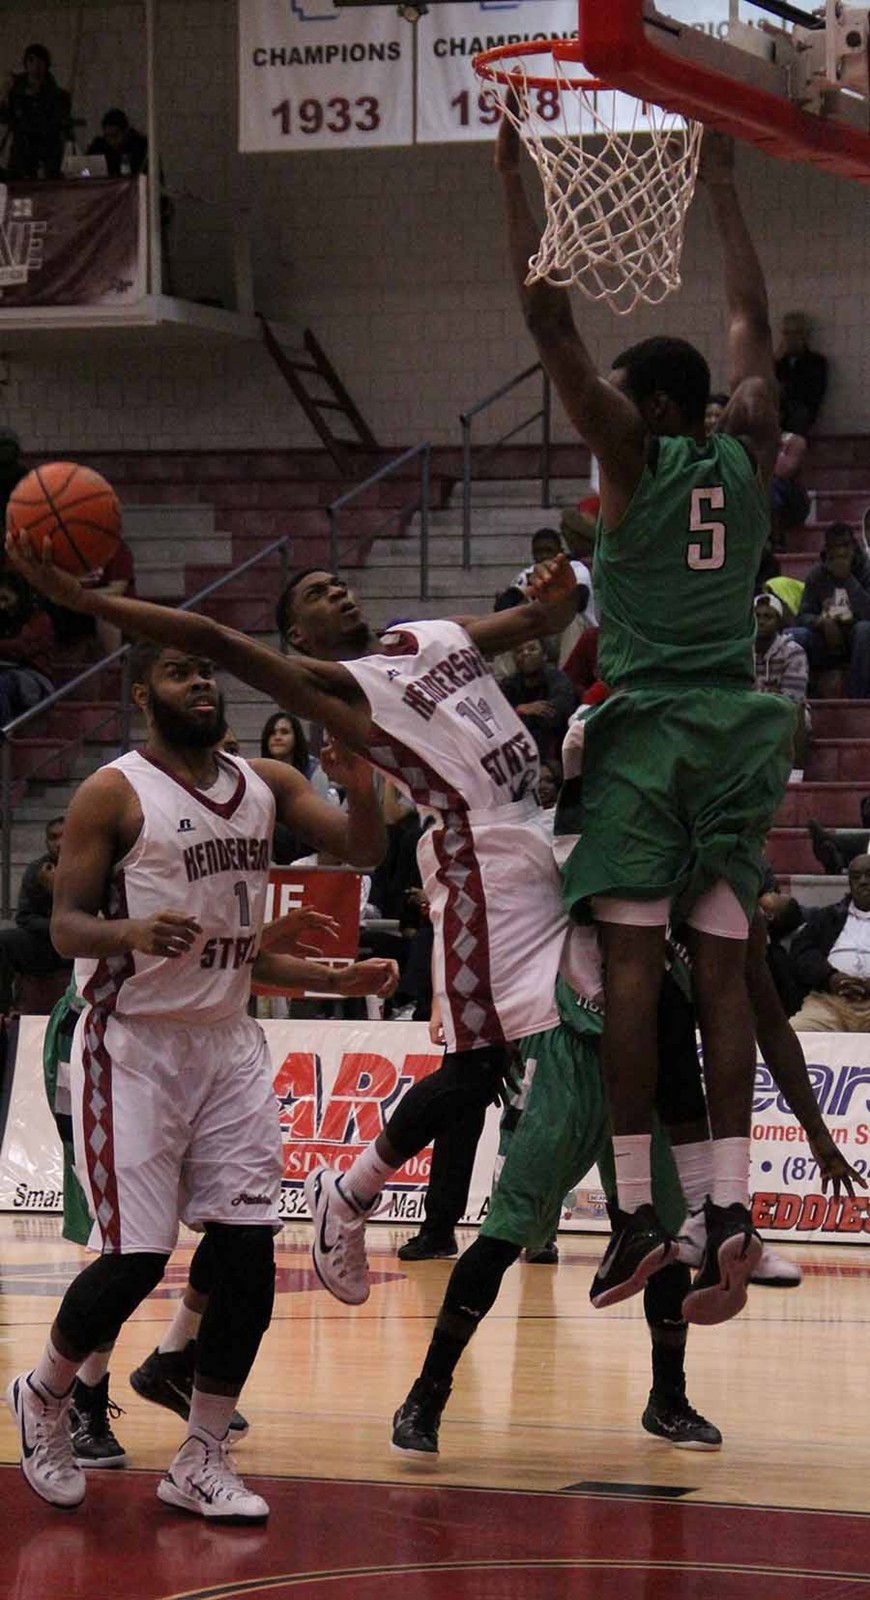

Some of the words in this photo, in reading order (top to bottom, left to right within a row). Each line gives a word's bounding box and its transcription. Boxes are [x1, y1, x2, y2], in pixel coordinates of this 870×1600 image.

[253, 41, 401, 67] CHAMPIONS
[271, 96, 380, 135] 1933
[451, 88, 560, 126] 198
[686, 486, 726, 570] 5
[183, 837, 270, 883] HENDERSO
[233, 880, 250, 927] 1
[287, 1151, 357, 1174] SINC
[13, 1183, 64, 1207] Smar
[751, 1191, 870, 1233] EDDIE
